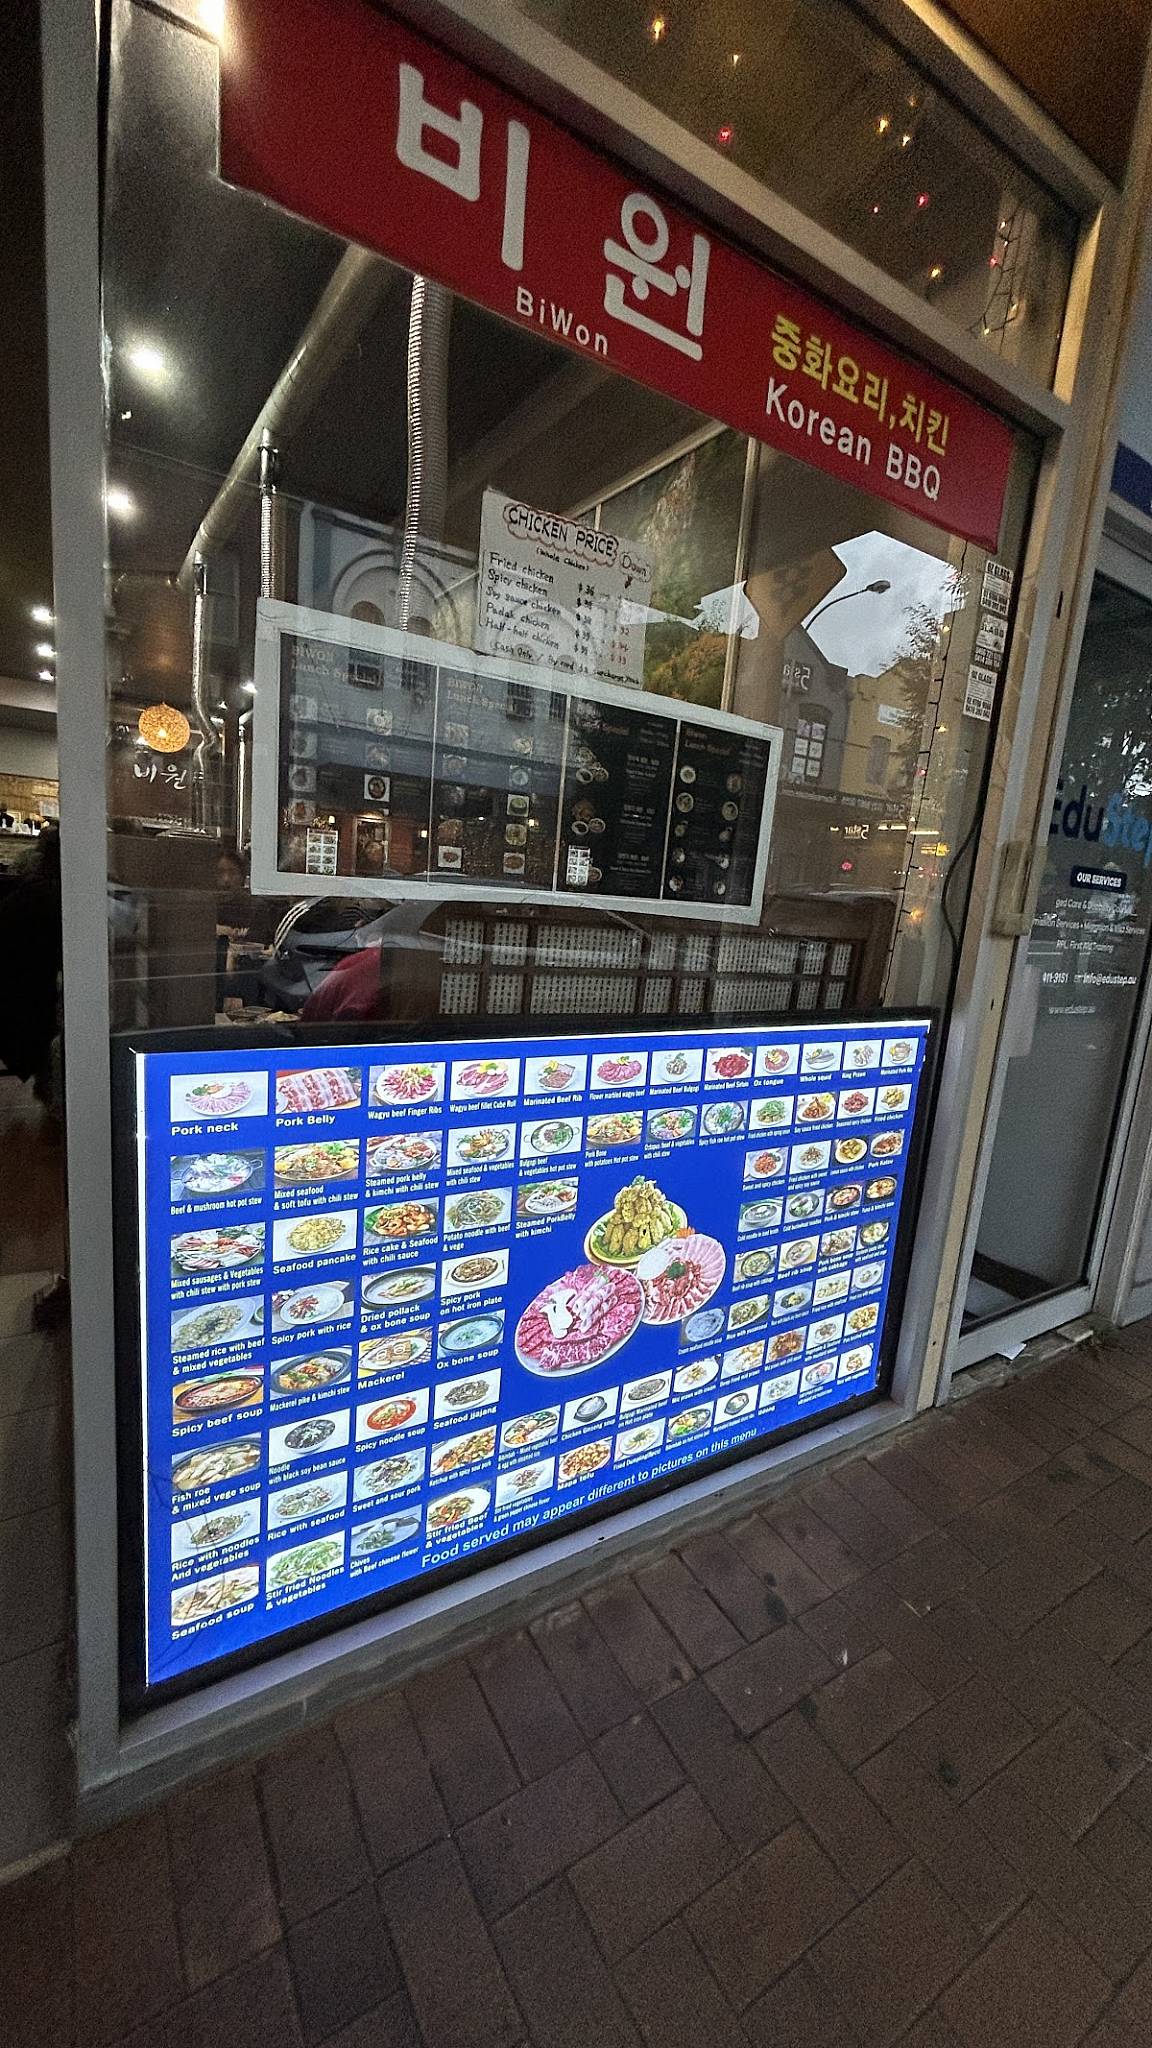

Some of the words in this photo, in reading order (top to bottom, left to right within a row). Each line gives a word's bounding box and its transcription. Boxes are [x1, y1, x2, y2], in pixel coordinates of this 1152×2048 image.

[516, 287, 609, 355] BiWon
[771, 313, 950, 455] 중화요리,치킨
[766, 377, 871, 465] Korean
[886, 442, 942, 502] BBQ
[509, 507, 568, 542] CHICKEN
[576, 531, 614, 556] PRICE
[489, 552, 517, 571] Fried
[522, 563, 554, 583] chicken
[488, 569, 512, 587] Spicy
[516, 579, 548, 597] chicken
[532, 598, 561, 615] chicken
[521, 612, 550, 631] chicken
[532, 633, 559, 650] chicken
[1077, 872, 1091, 884] OUR
[1092, 875, 1121, 887] SERVICES
[524, 1096, 555, 1106] Marinated
[557, 1095, 570, 1103] Beef
[573, 1094, 583, 1102] Rib
[276, 1117, 303, 1127] Pork
[307, 1115, 335, 1125] Belly
[368, 1110, 390, 1121] Wagyu
[392, 1108, 406, 1117] beef
[408, 1107, 427, 1117] Finger
[428, 1106, 442, 1114] Ribs
[171, 1124, 203, 1136] Pork
[207, 1122, 238, 1133] neck
[365, 1189, 371, 1197] &
[372, 1186, 394, 1197] kimchi
[396, 1185, 408, 1194] with
[410, 1183, 423, 1192] chili
[424, 1181, 439, 1190] stew
[366, 1175, 395, 1188] Steamed
[396, 1175, 410, 1184] pork
[412, 1172, 427, 1182] belly
[274, 1188, 295, 1199] Mixed
[297, 1186, 324, 1197] seafood
[171, 1204, 185, 1215] Beef
[194, 1200, 225, 1212] mushroom
[226, 1199, 236, 1208] hot
[238, 1198, 247, 1208] pot
[249, 1196, 262, 1206] stew
[363, 1246, 379, 1256] Rice
[381, 1244, 399, 1253] cake
[401, 1241, 406, 1249] &
[409, 1236, 438, 1247] Seafood
[273, 1260, 314, 1275] Seafood
[317, 1253, 356, 1269] pancake
[363, 1257, 378, 1266] with
[380, 1254, 396, 1264] chili
[397, 1251, 419, 1260] sauce
[440, 1295, 461, 1306] Spicy
[463, 1291, 481, 1302] pork
[440, 1307, 449, 1315] on
[452, 1303, 465, 1312] hot
[467, 1300, 482, 1310] iron
[483, 1295, 502, 1308] plate
[360, 1324, 368, 1333] &
[371, 1322, 381, 1331] ox
[384, 1317, 406, 1328] bone
[410, 1312, 431, 1323] soup
[361, 1311, 385, 1323] Dried
[388, 1305, 420, 1319] pollack
[272, 1334, 294, 1345] Spicy
[297, 1330, 315, 1341] pork
[318, 1324, 334, 1336] with
[336, 1321, 352, 1332] rice
[173, 1346, 209, 1364] Steamed
[211, 1345, 227, 1357] rice
[228, 1341, 245, 1353] with
[248, 1338, 265, 1350] beef
[437, 1360, 449, 1369] Ox
[452, 1353, 474, 1367] bone
[478, 1349, 499, 1360] soup
[173, 1367, 179, 1376] &
[182, 1361, 207, 1373] mixed
[208, 1352, 252, 1367] vegetables
[358, 1372, 405, 1390] Mackerel
[172, 1422, 203, 1437] Spicy
[207, 1414, 233, 1428] beef
[236, 1407, 263, 1422] soup
[355, 1441, 377, 1453] Spicy
[378, 1433, 405, 1447] noodle
[407, 1428, 426, 1439] soup
[562, 1431, 581, 1441] Chicken
[172, 1492, 192, 1504] Fish
[194, 1487, 210, 1498] roe
[172, 1506, 180, 1515] &
[183, 1498, 211, 1512] mixed
[214, 1490, 236, 1503] vege
[239, 1482, 261, 1495] soup
[353, 1501, 374, 1513] Sweet
[376, 1496, 388, 1507] and
[391, 1492, 405, 1502] sour
[406, 1485, 421, 1498] pork
[421, 1545, 459, 1568] Food
[462, 1525, 509, 1552] served
[512, 1515, 540, 1534] may
[543, 1495, 585, 1520] appear
[588, 1476, 635, 1501] different
[638, 1470, 649, 1482] to
[652, 1451, 693, 1477] pictures
[696, 1446, 708, 1458] on
[711, 1438, 729, 1453] this
[731, 1429, 757, 1444] menu
[267, 1530, 287, 1541] Rice
[290, 1522, 308, 1534] with
[310, 1510, 345, 1527] seafood
[172, 1558, 194, 1572] Rice
[198, 1551, 218, 1564] with
[221, 1537, 260, 1555] noodles
[172, 1569, 191, 1582] And
[195, 1550, 249, 1574] vegetables
[266, 1589, 282, 1601] Stir
[285, 1580, 306, 1593] fried
[309, 1566, 345, 1585] Noodles
[266, 1602, 273, 1611] &
[277, 1582, 326, 1606] vegetables
[172, 1614, 223, 1641] Seafood
[226, 1602, 255, 1620] soup
